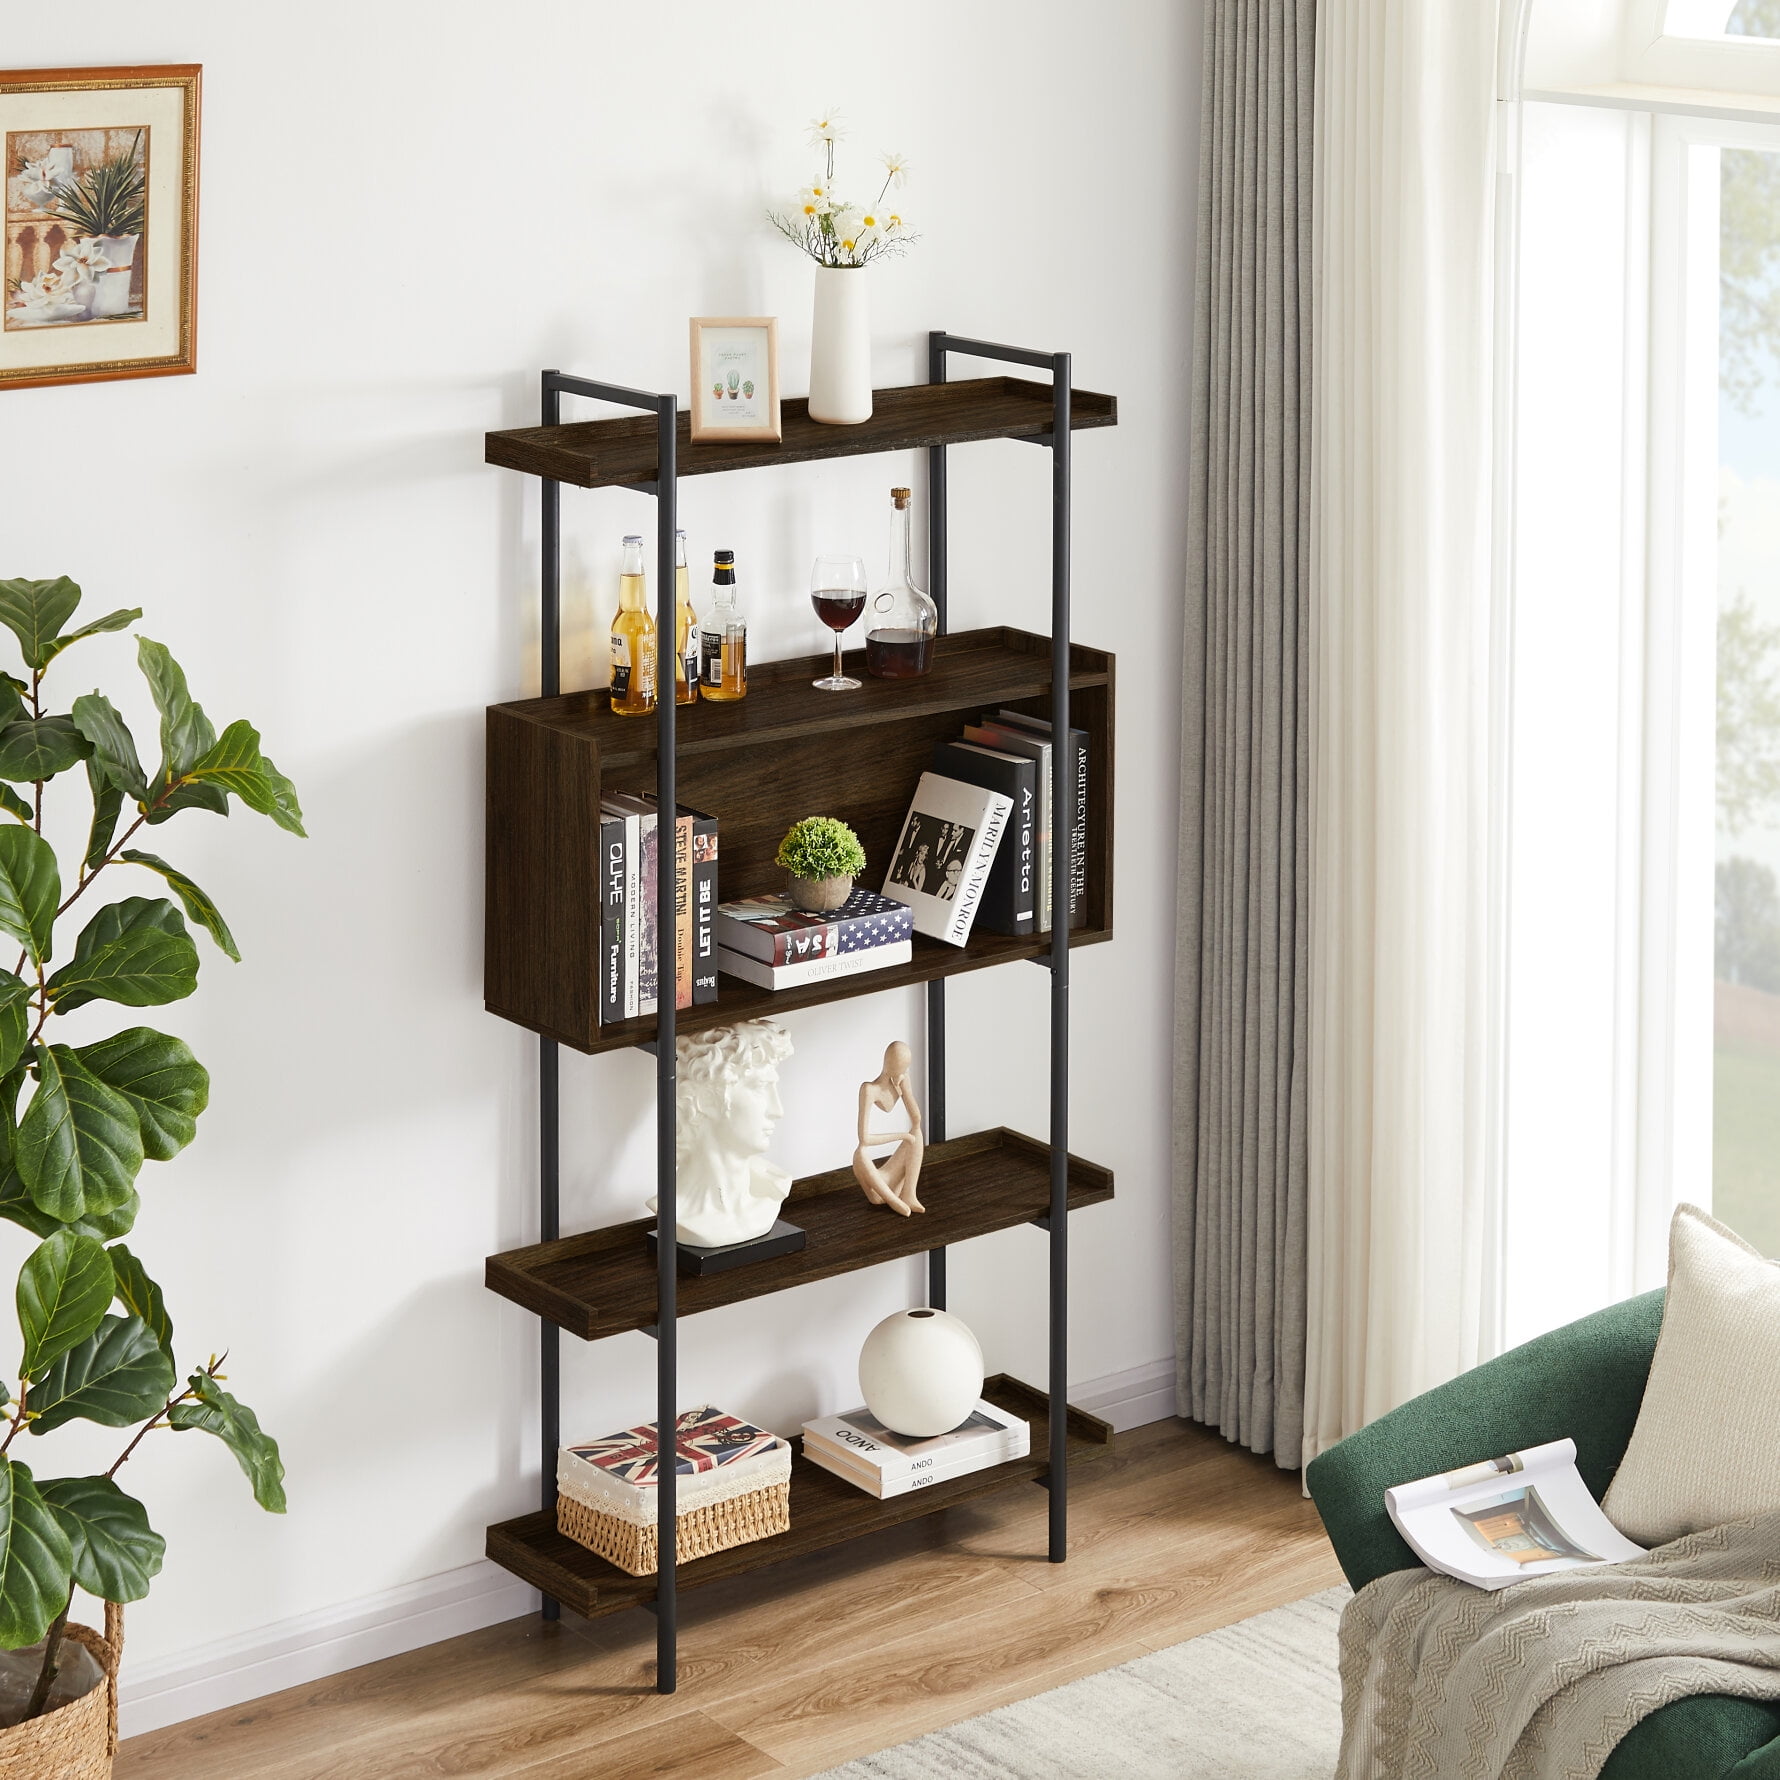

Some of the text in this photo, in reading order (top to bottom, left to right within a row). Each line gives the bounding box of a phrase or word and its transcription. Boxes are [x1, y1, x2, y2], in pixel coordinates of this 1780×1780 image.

[1021, 787, 1033, 893] Arletta
[676, 825, 687, 916] STEVE MARTINI
[951, 803, 1007, 941] MARILYN MONROE
[1075, 867, 1085, 896] THE
[1069, 877, 1077, 914] CENTURY
[699, 879, 711, 958] LET IT BE
[610, 944, 619, 1004] Furniture
[807, 958, 864, 978] OLIVER TWIST
[836, 1429, 881, 1452] ANDO
[911, 1458, 933, 1471] ANDO
[911, 1475, 934, 1488] ANDO
